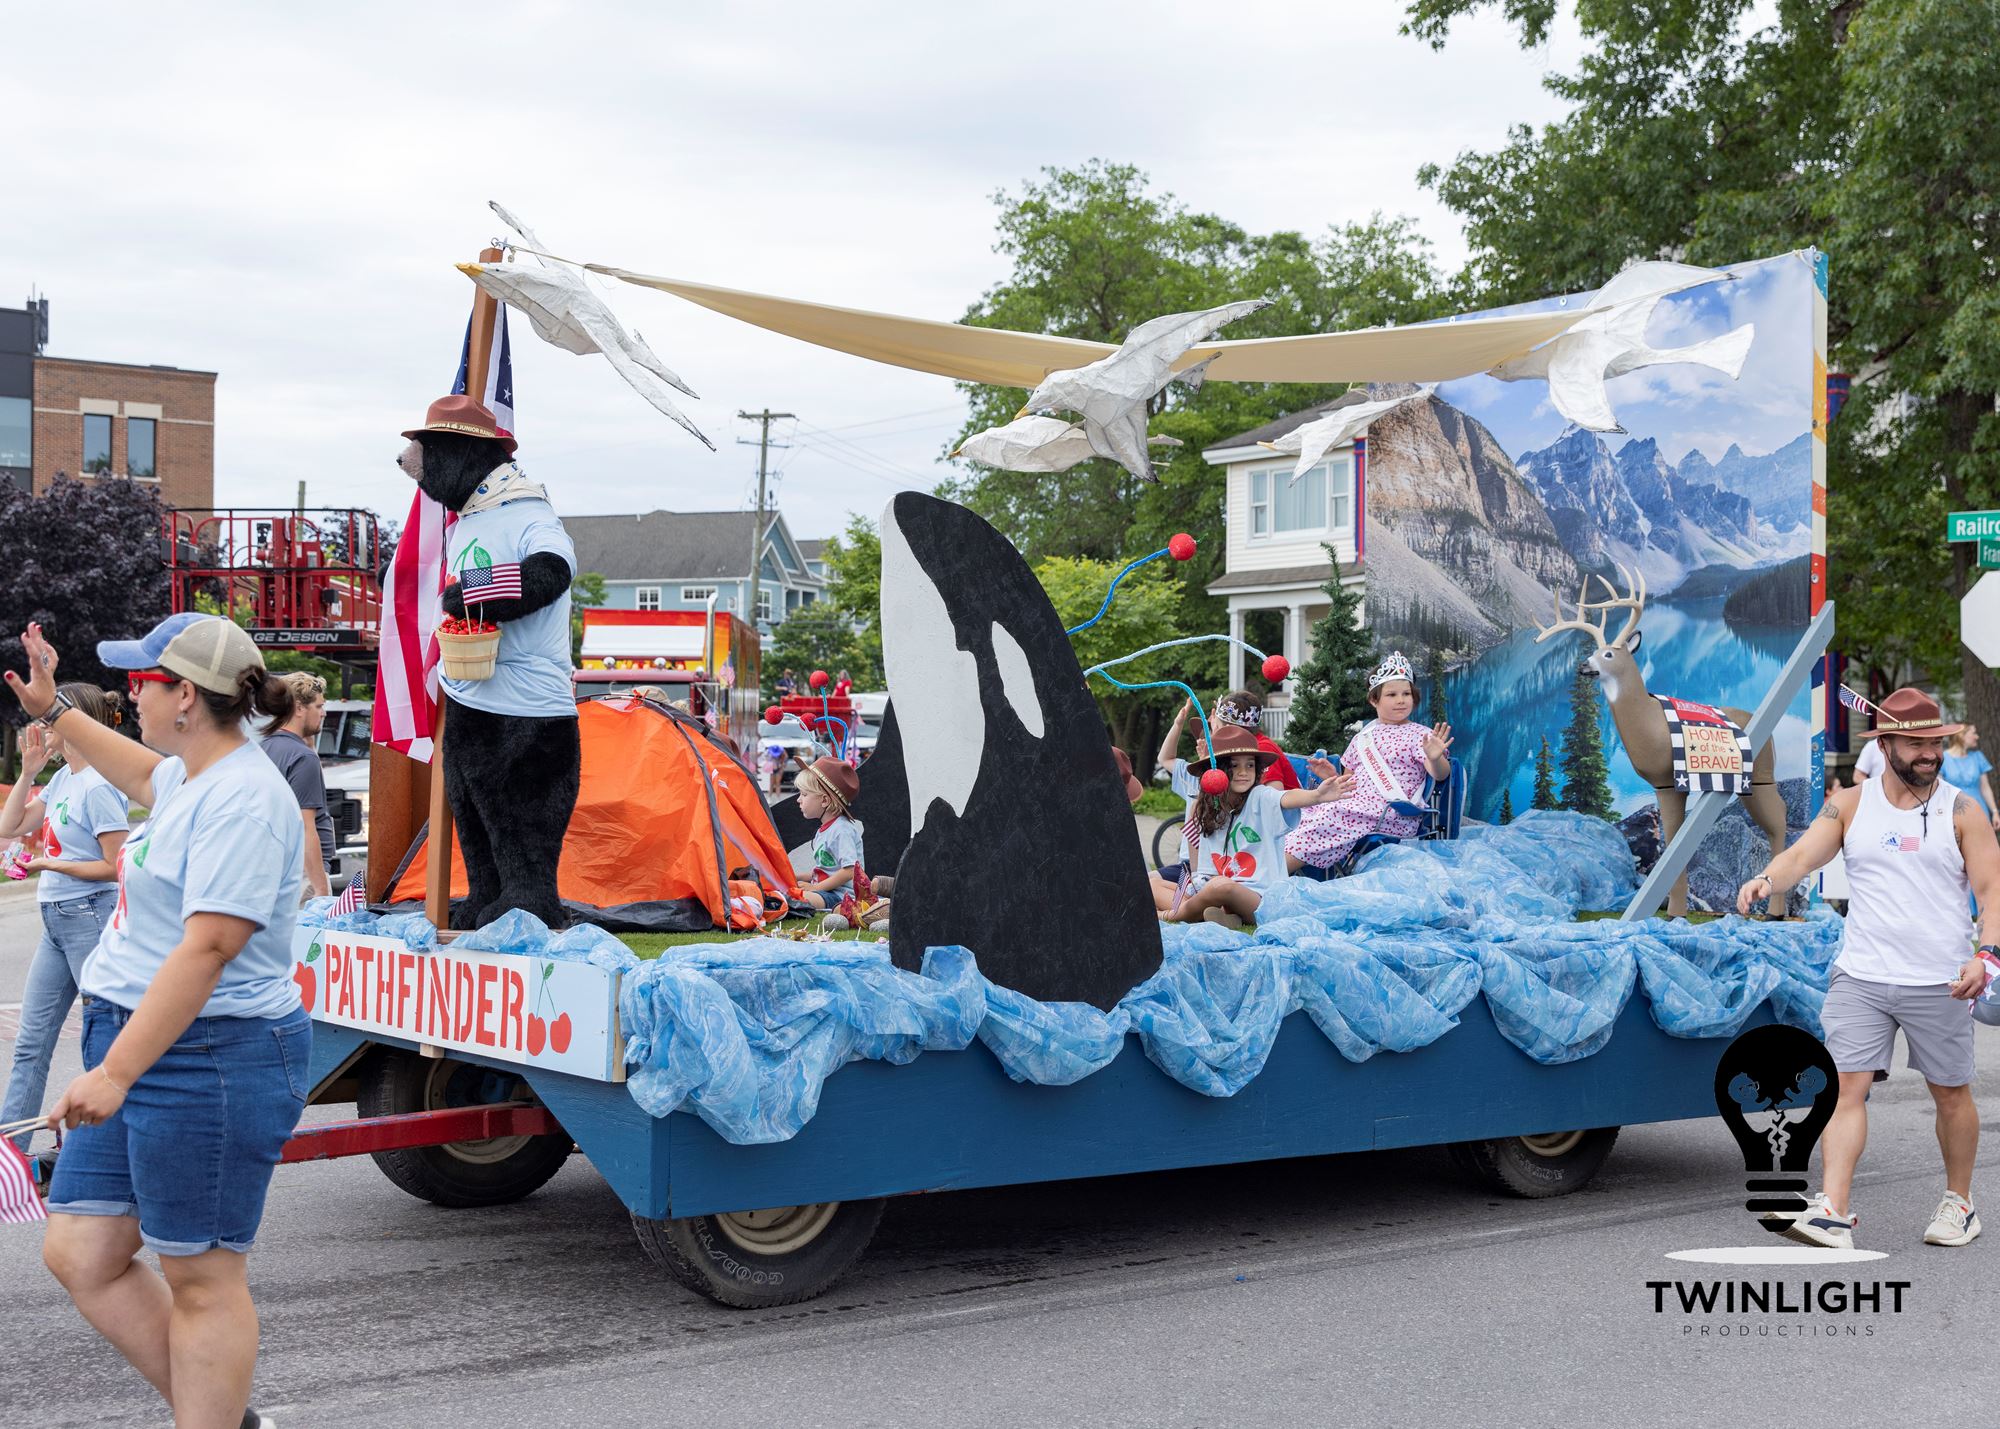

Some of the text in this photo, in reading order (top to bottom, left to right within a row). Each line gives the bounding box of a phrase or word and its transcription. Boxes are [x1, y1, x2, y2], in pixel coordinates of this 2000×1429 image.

[459, 424, 479, 433] JUNIOR
[278, 632, 339, 642] DESIGN
[1689, 729, 1730, 743] HOME
[1700, 742, 1726, 753] of the
[1690, 755, 1740, 770] BRAVE
[325, 943, 524, 1051] PATHFINDER
